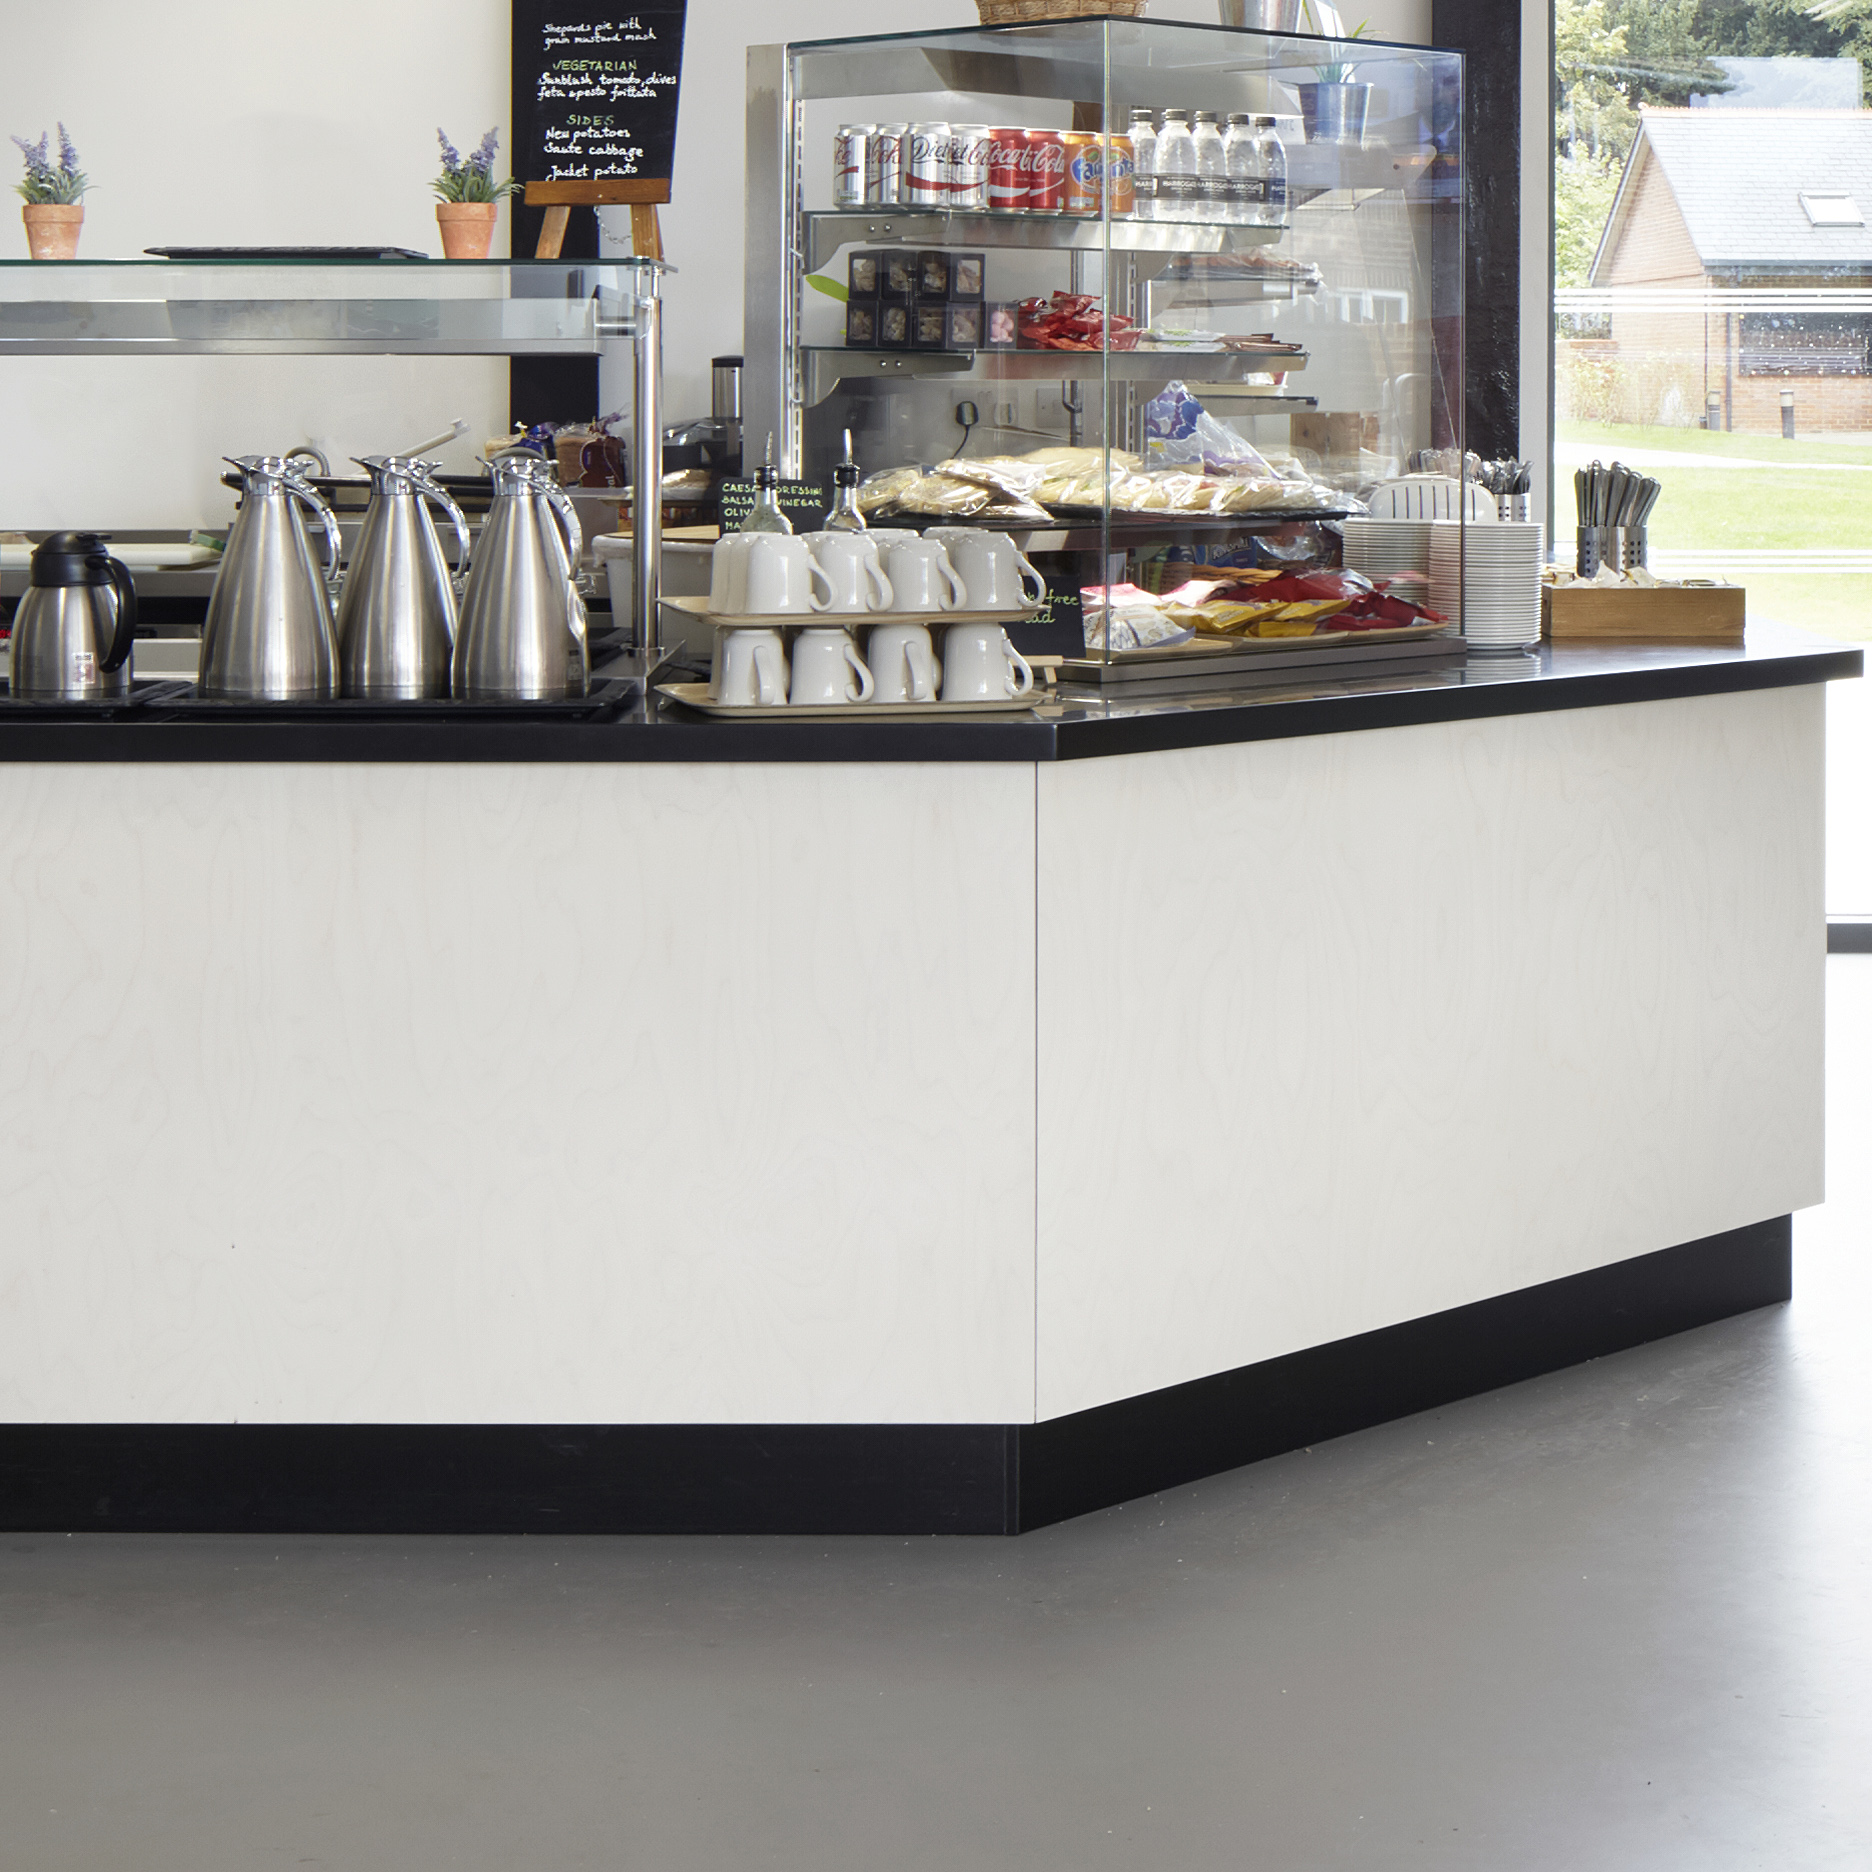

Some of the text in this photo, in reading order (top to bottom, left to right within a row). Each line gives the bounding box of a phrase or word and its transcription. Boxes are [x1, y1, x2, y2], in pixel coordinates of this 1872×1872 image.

[552, 59, 638, 72] VEGETARIAN
[537, 85, 566, 101] feta
[566, 114, 615, 126] SIDES
[545, 126, 631, 143] New potatoes
[593, 162, 639, 181] potato
